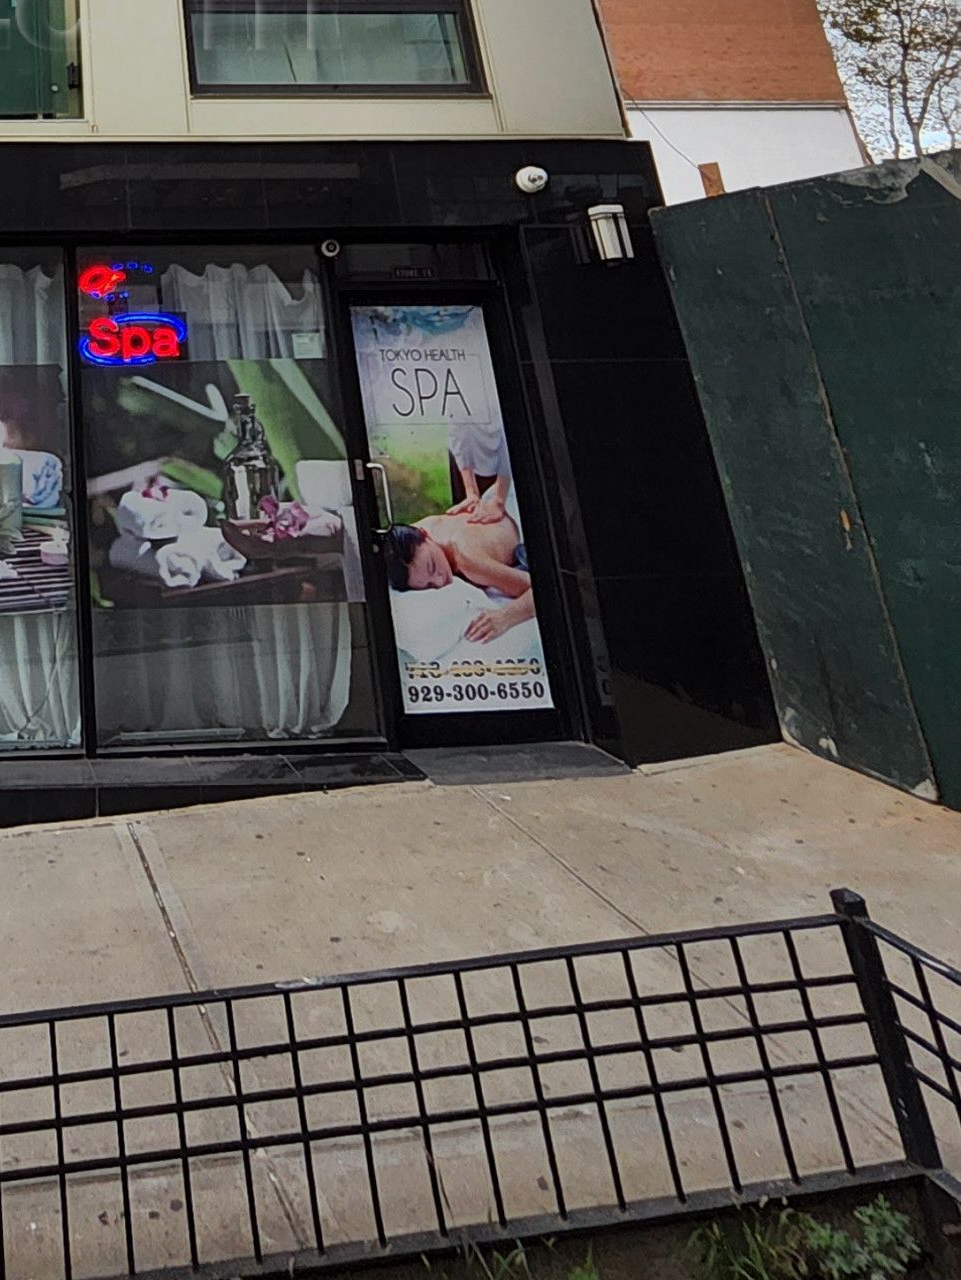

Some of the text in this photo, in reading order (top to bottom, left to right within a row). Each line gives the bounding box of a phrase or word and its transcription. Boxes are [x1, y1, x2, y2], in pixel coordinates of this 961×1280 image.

[88, 317, 180, 360] Spa
[379, 348, 466, 362] TOKYO HEALTH
[391, 367, 472, 418] SPA
[407, 681, 545, 703] 929-300-6550
